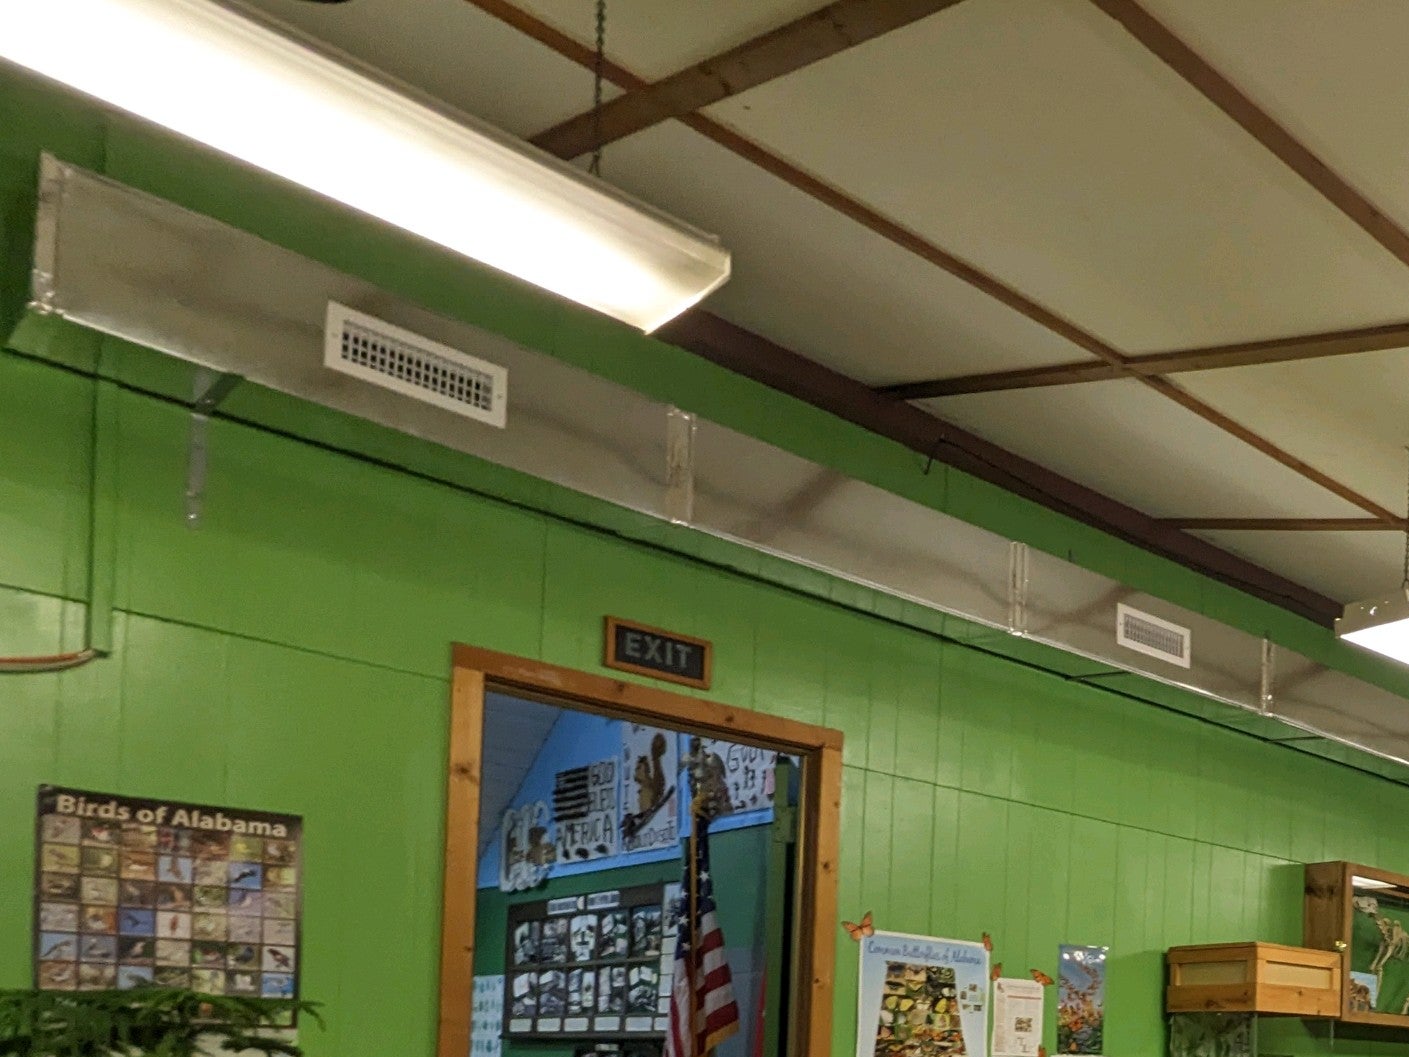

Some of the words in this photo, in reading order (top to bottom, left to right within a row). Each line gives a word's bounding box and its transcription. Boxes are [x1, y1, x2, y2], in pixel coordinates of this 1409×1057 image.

[625, 632, 692, 668] EXIT
[56, 794, 130, 821] Birds
[136, 806, 168, 824] of
[171, 809, 287, 838] Alabama
[868, 940, 899, 955] Common
